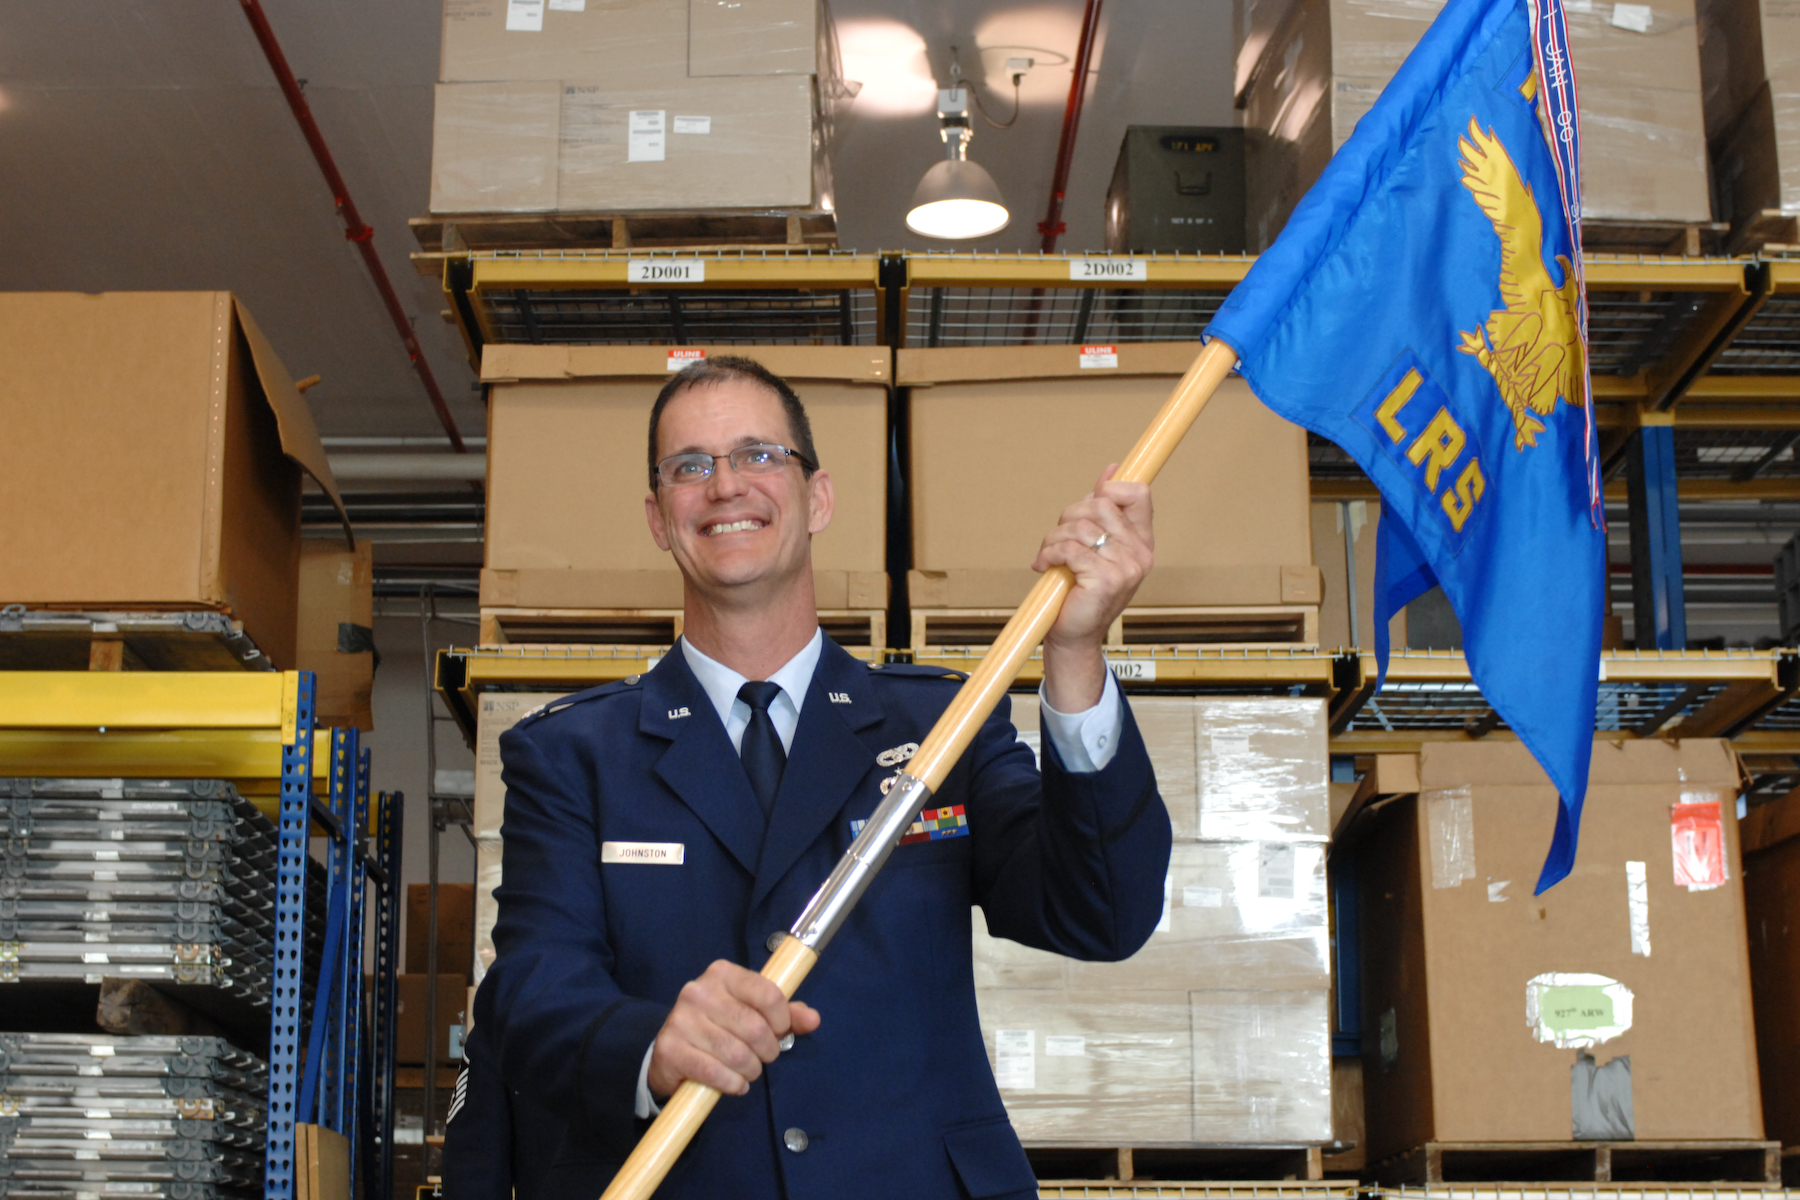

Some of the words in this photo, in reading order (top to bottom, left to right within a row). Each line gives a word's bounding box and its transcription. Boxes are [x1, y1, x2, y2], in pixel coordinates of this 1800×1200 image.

[1545, 41, 1568, 88] JAN
[641, 265, 690, 279] 2D001
[1084, 262, 1134, 276] 2D002
[673, 350, 701, 358] ULINE
[1084, 346, 1113, 355] ULINE
[1373, 365, 1486, 533] LRS
[1108, 663, 1143, 678] 002
[829, 691, 853, 704] U.S.
[496, 701, 520, 711] NSP
[667, 706, 691, 720] U.S.
[619, 848, 667, 858] JOHNSTON
[1581, 1008, 1605, 1018] ARW
